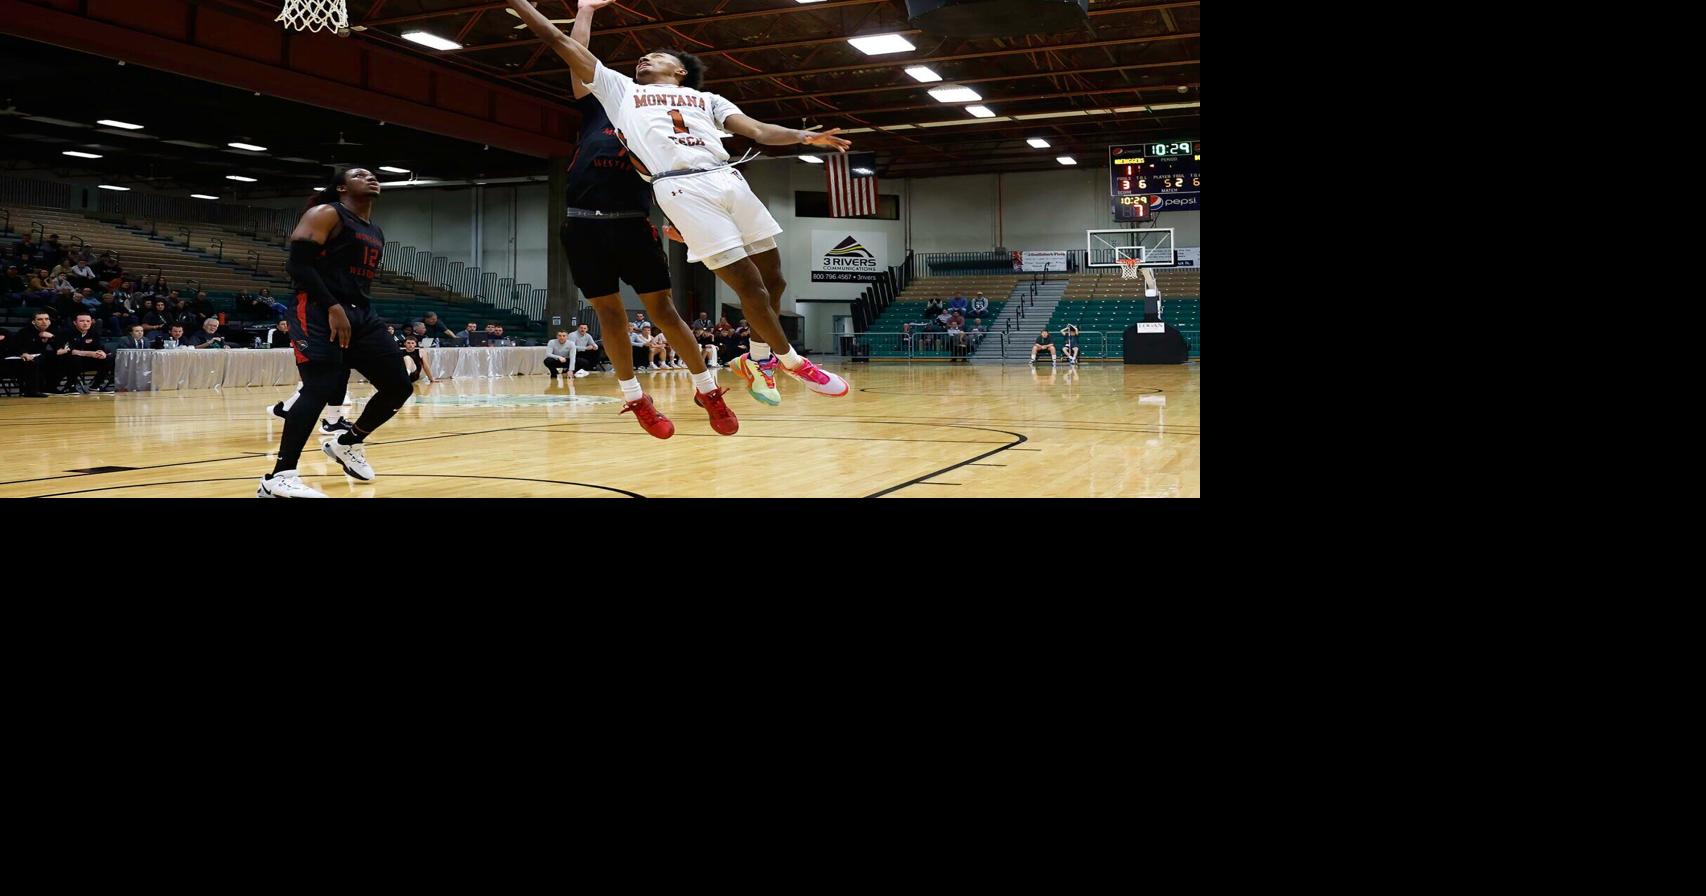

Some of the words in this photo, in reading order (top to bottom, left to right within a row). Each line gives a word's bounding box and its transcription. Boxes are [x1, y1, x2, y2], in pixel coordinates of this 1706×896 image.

[633, 93, 706, 111] MONTANA
[667, 109, 690, 135] 1
[1152, 142, 1190, 156] 10:29
[1122, 180, 1130, 190] 3
[1138, 179, 1147, 189] 6
[1175, 177, 1183, 188] 2
[1120, 196, 1148, 205] 10:29
[1165, 198, 1197, 206] pepsi
[1134, 205, 1143, 217] 7
[363, 246, 379, 267] 12
[833, 258, 877, 267] RIVERS
